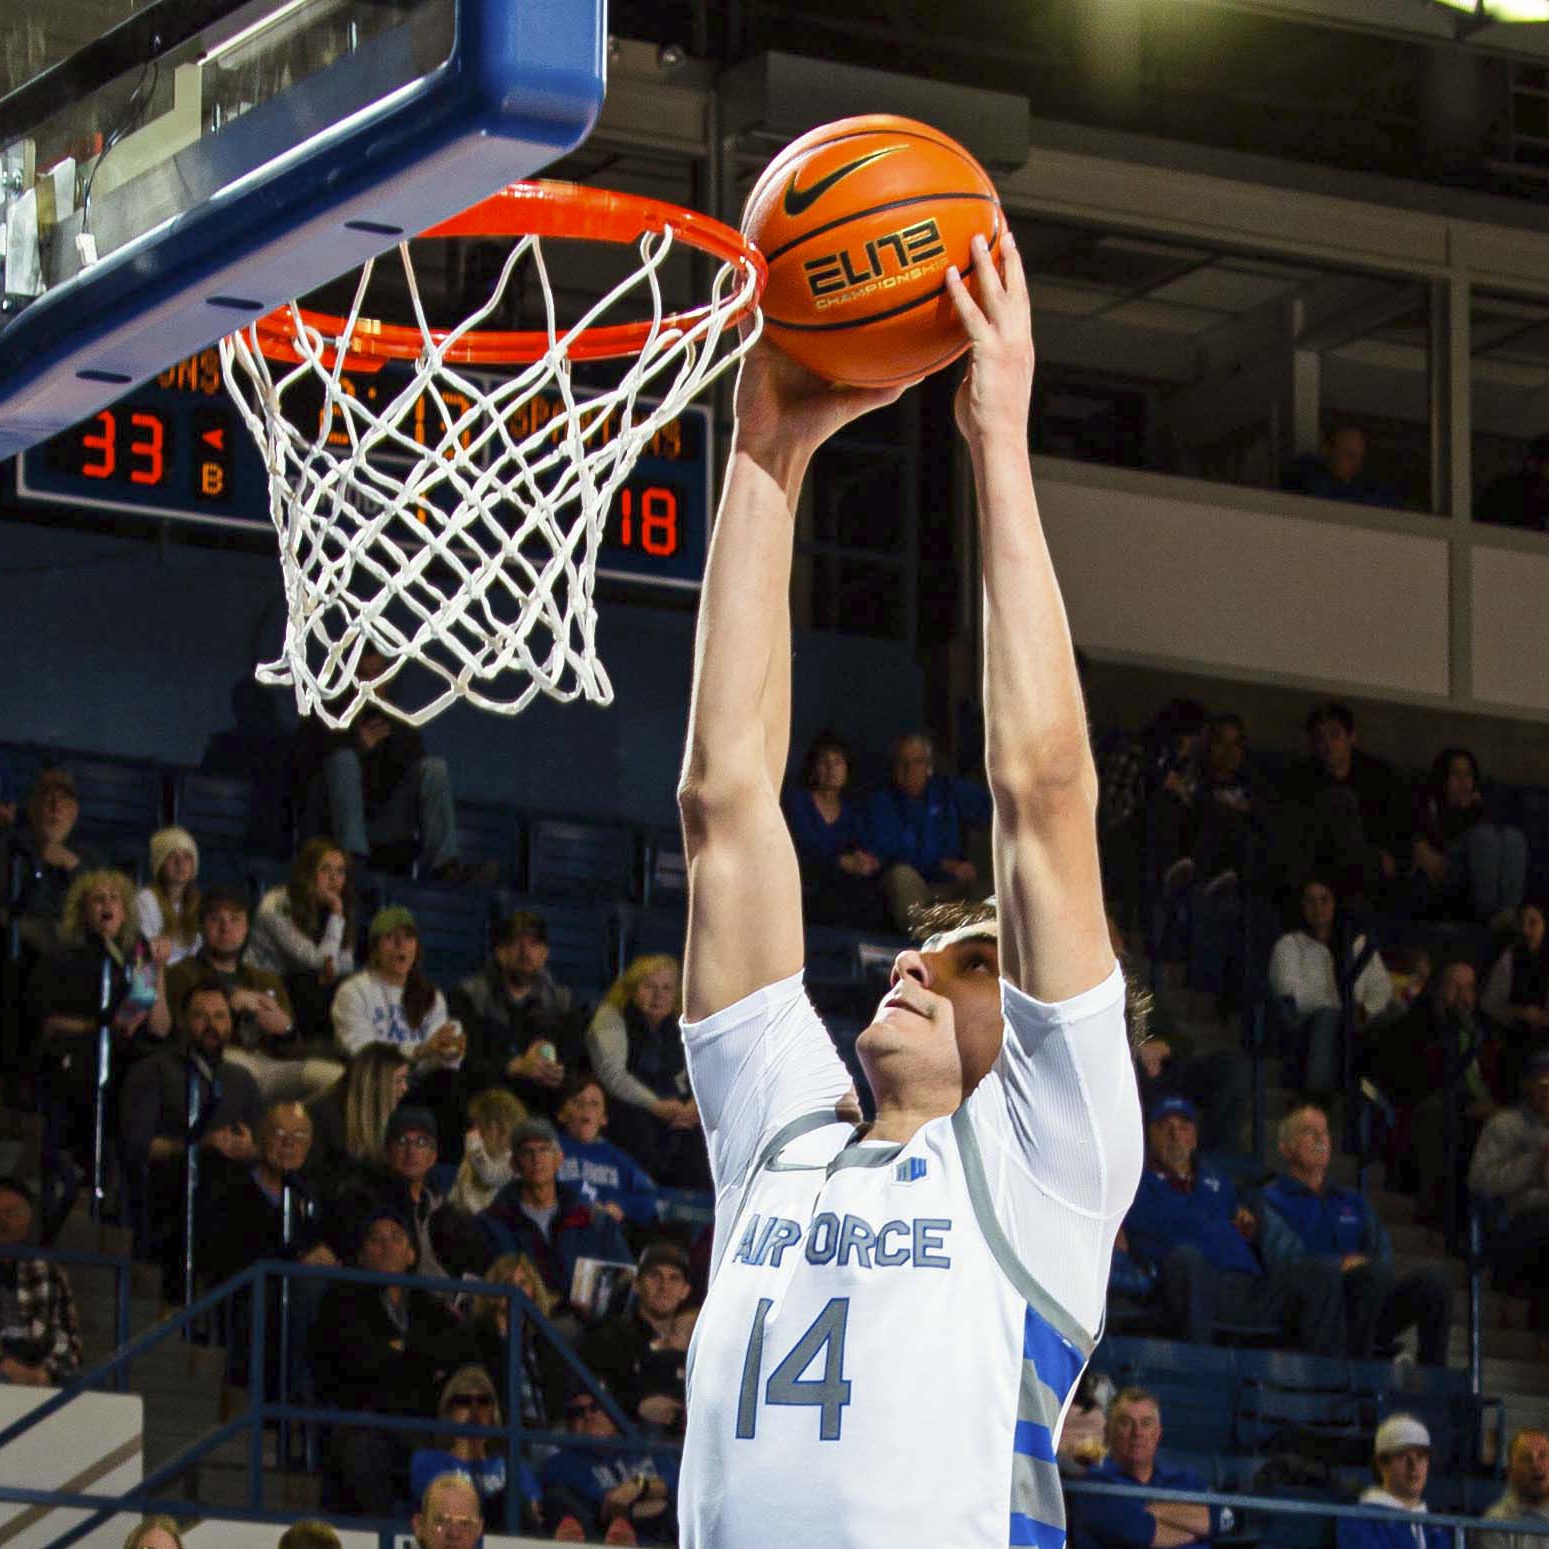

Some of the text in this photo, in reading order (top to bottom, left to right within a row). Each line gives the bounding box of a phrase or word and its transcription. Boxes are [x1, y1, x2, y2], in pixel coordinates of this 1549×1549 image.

[82, 410, 164, 486] 33
[620, 487, 677, 557] 18
[733, 1211, 952, 1269] AIR ORCE
[734, 1297, 852, 1441] 14
